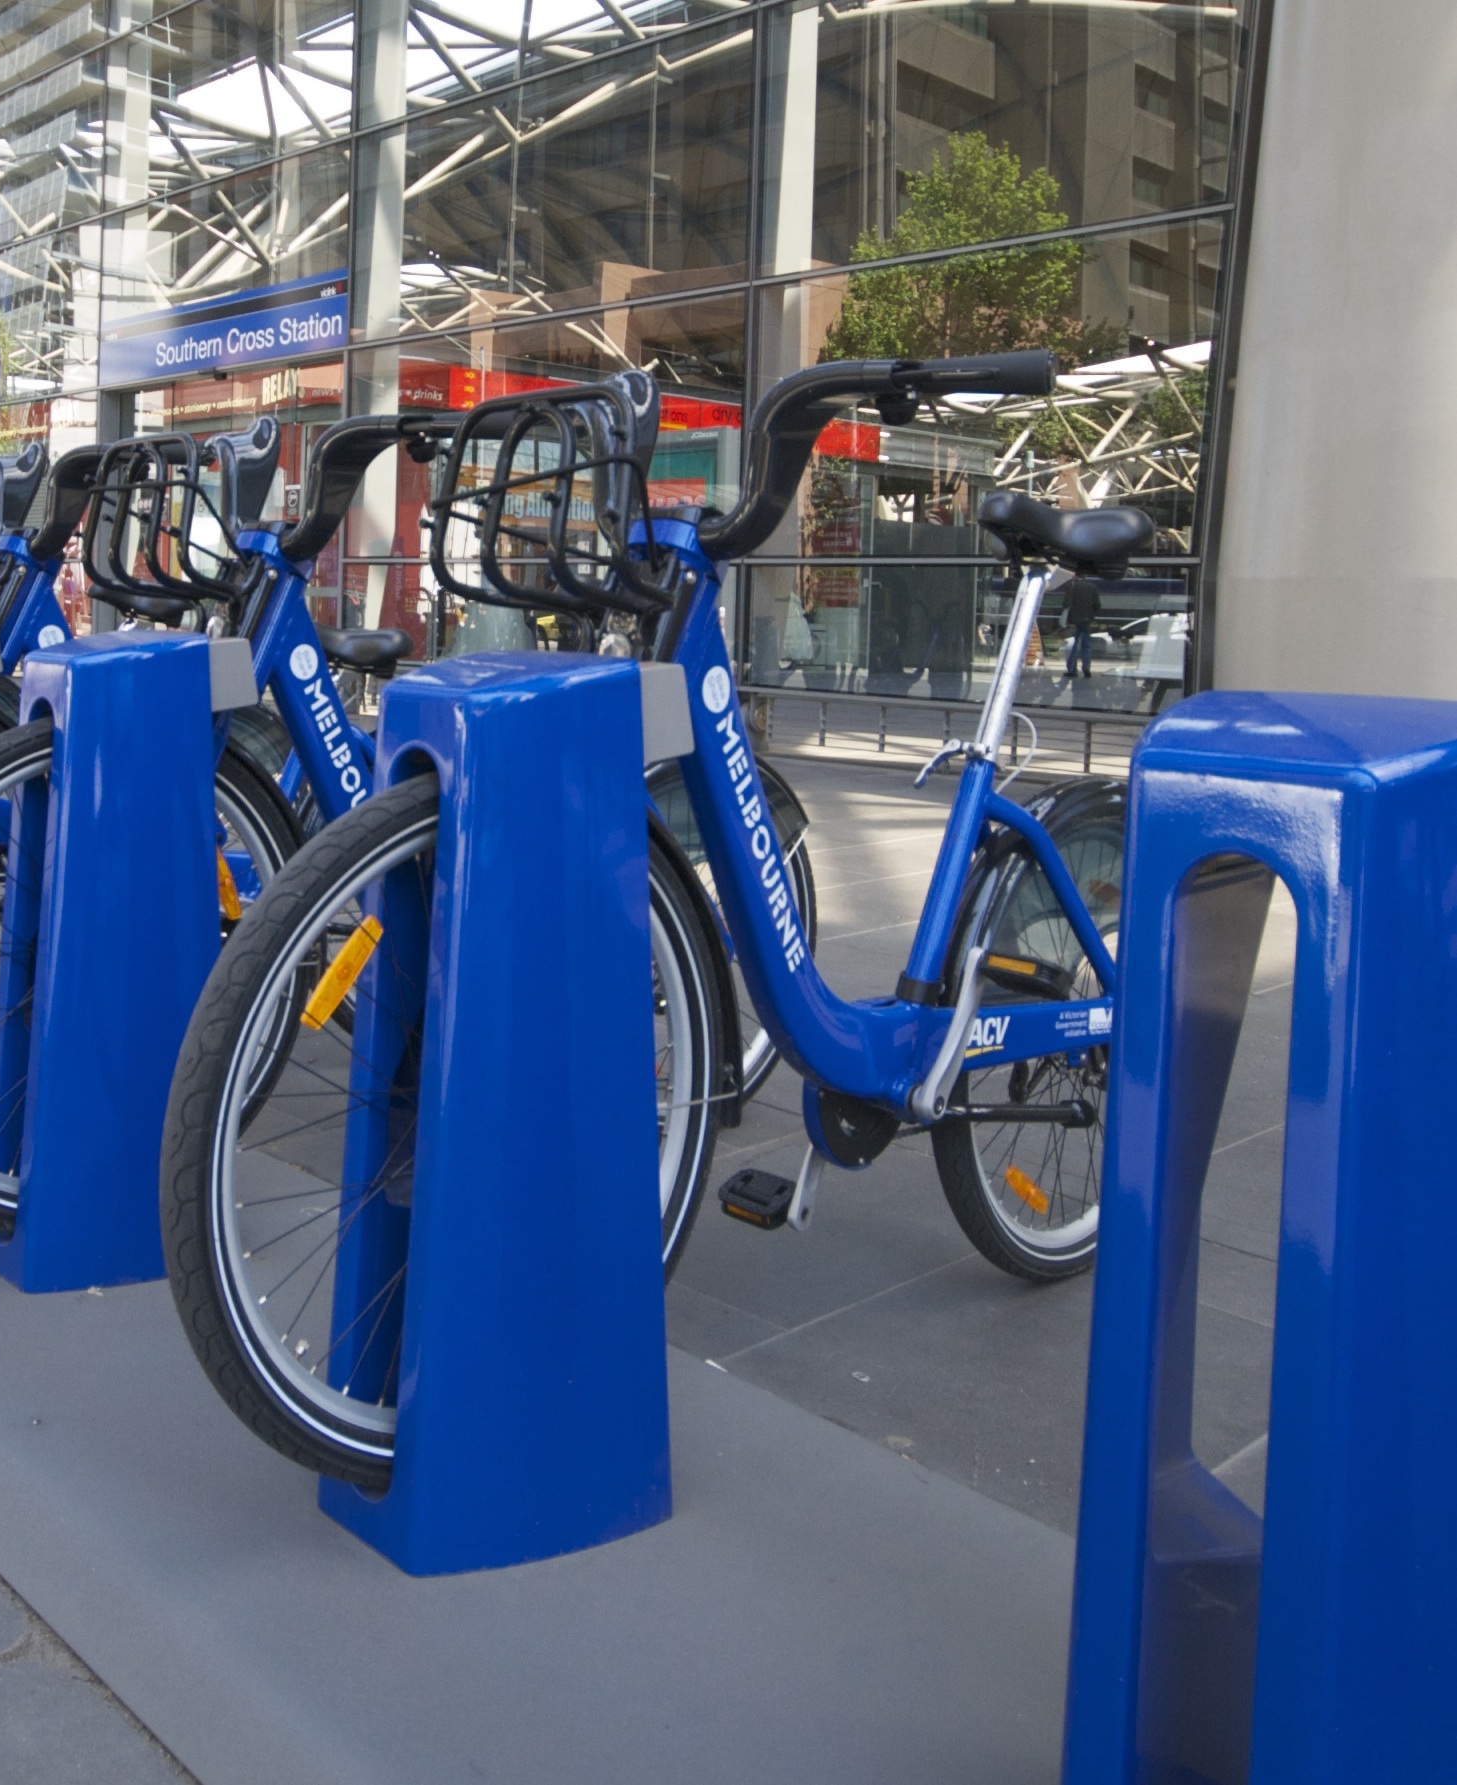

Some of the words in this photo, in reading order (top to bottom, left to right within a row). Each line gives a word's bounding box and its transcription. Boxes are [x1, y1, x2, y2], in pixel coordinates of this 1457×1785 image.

[155, 338, 222, 367] Southern
[227, 328, 274, 355] Cross
[279, 312, 342, 345] Station
[413, 386, 443, 401] drinks
[712, 407, 732, 423] dry
[304, 678, 367, 809] MELBO
[716, 711, 804, 973] MELBOURNE
[968, 1016, 1011, 1047] ACV
